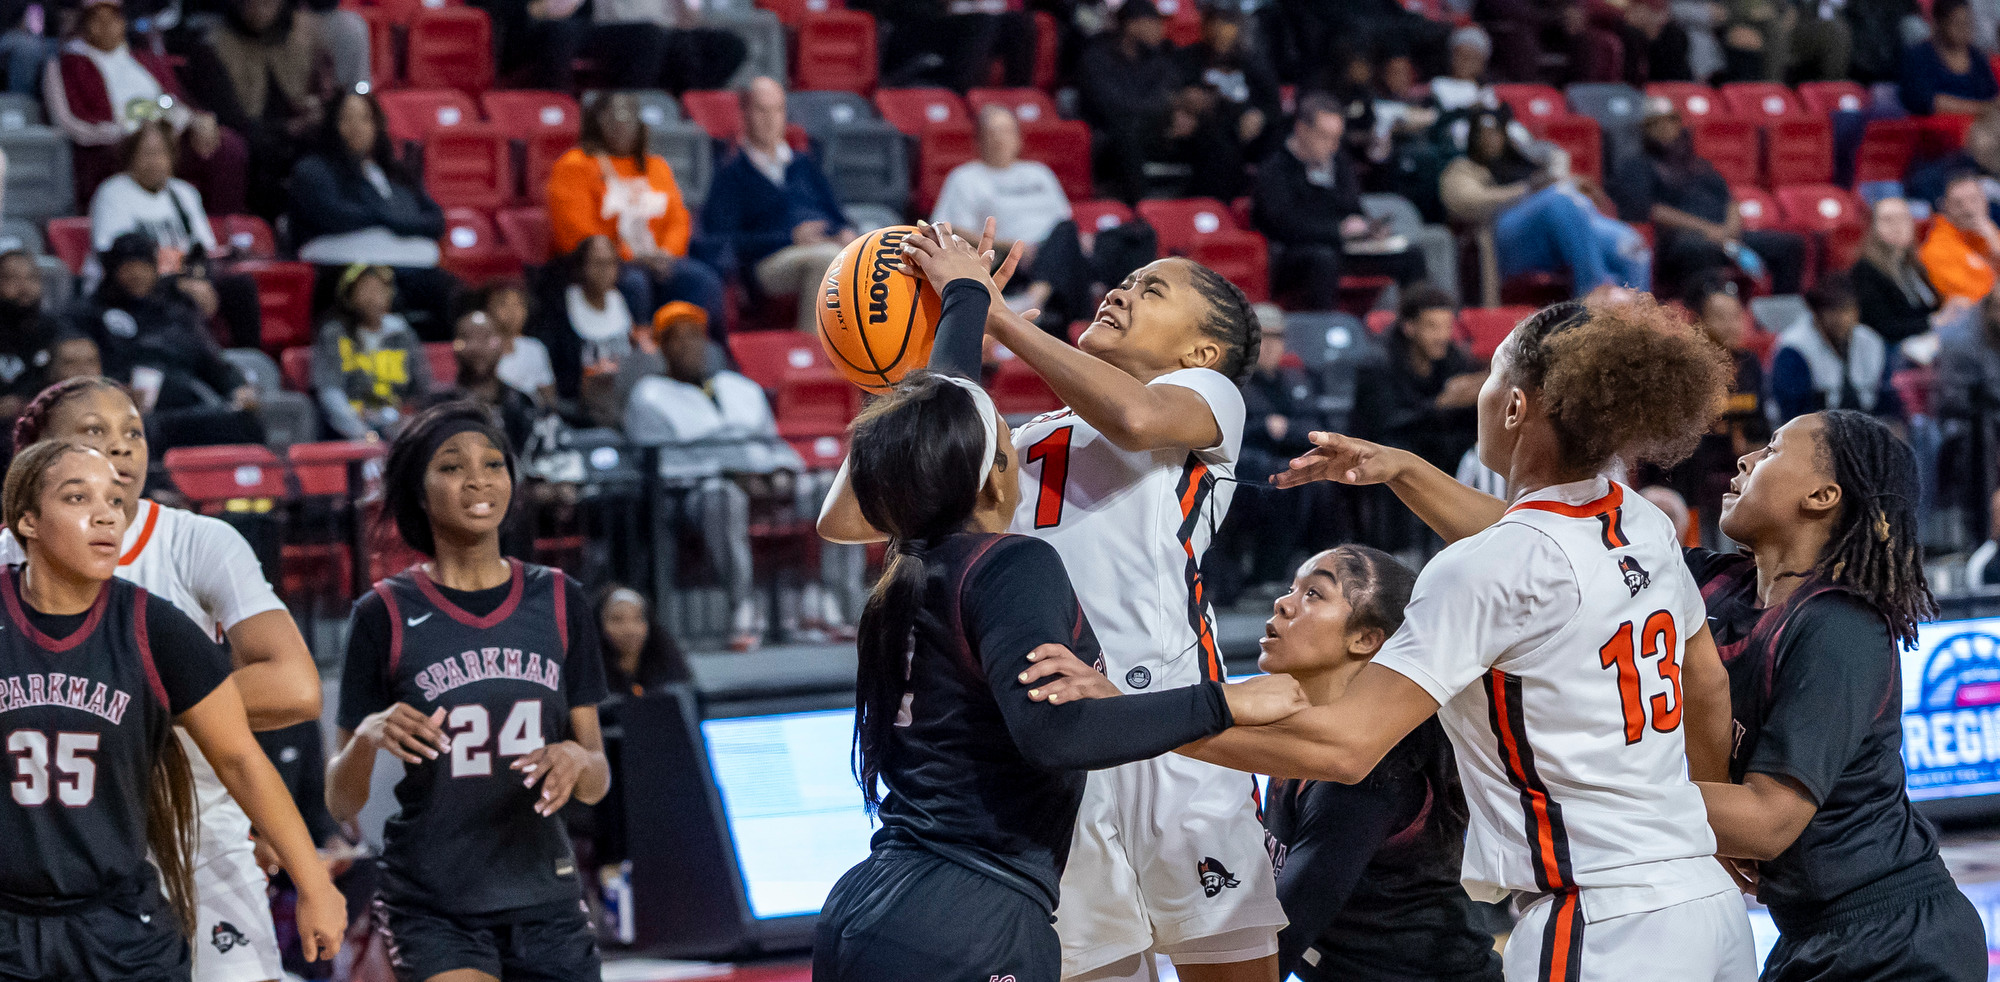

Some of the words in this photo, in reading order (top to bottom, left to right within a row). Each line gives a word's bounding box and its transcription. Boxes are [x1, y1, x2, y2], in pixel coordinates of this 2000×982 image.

[869, 230, 913, 325] Wilson
[1026, 424, 1074, 530] 1
[414, 647, 560, 702] SPARKMAN
[1599, 609, 1682, 746] 13
[6, 728, 101, 808] 35
[448, 699, 545, 778] 24
[1904, 708, 2000, 770] REGI
